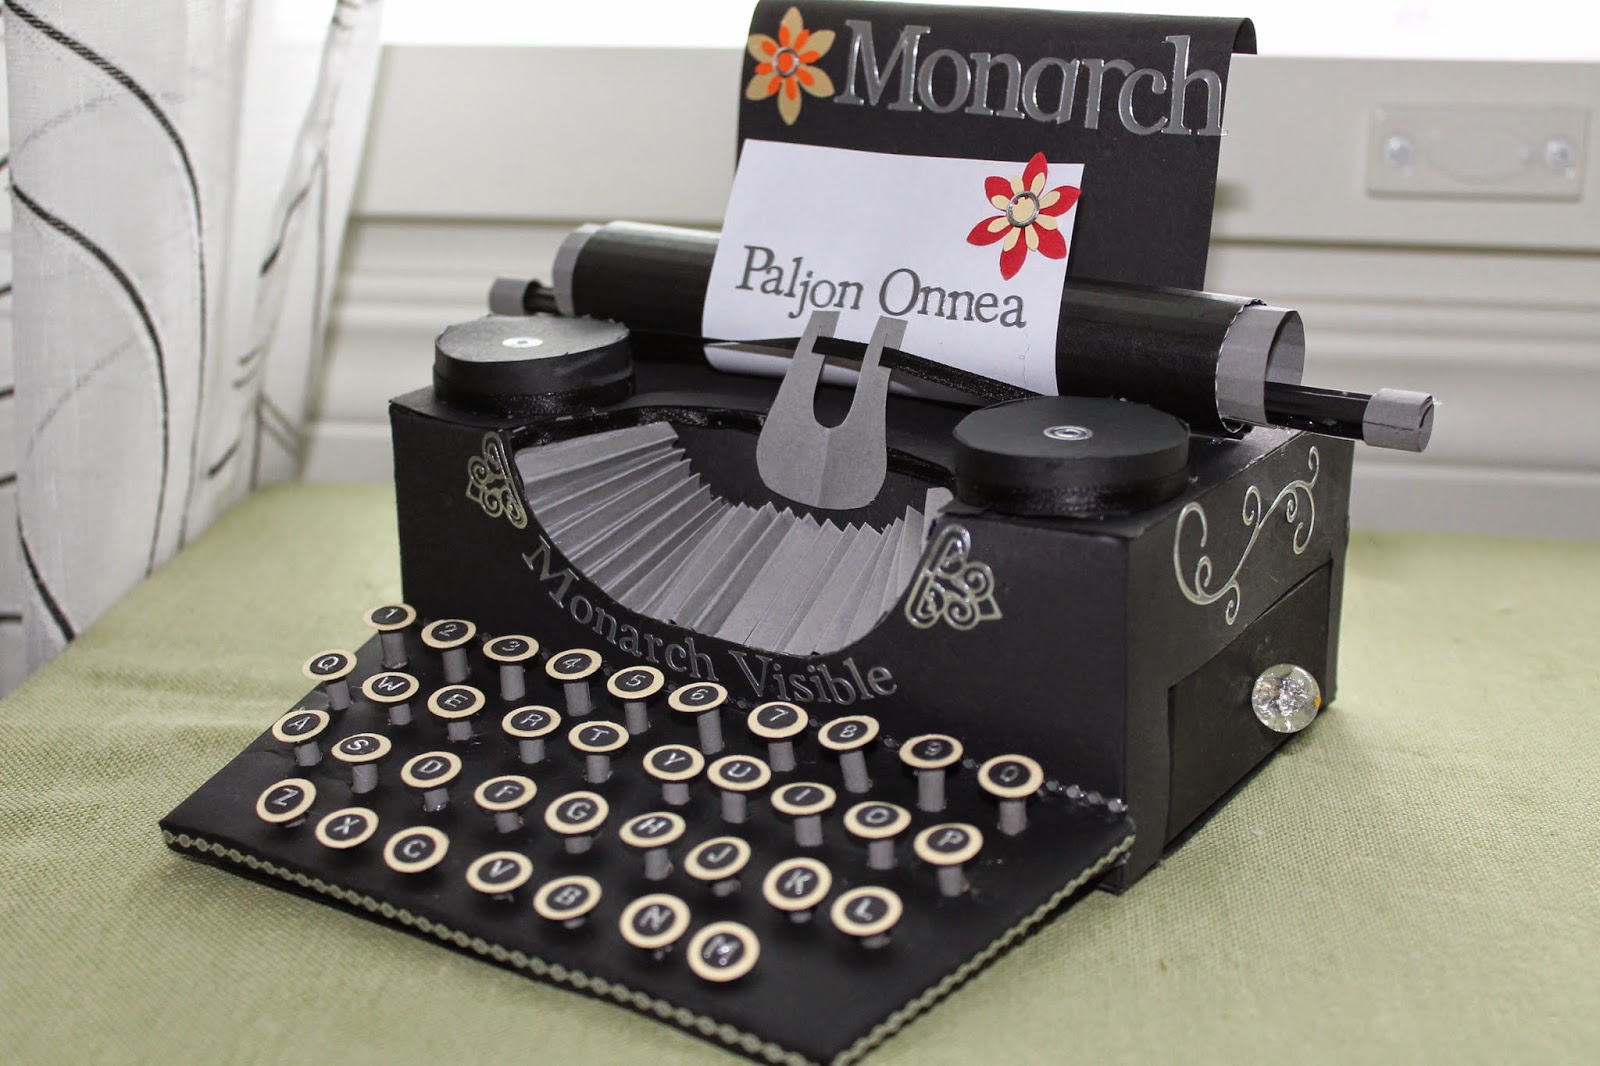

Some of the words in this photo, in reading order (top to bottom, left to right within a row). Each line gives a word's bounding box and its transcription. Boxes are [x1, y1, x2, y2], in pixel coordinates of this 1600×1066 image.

[833, 19, 1228, 136] Monarch
[735, 245, 863, 319] Paljon
[878, 268, 1028, 330] Onnea
[438, 623, 458, 637] 2
[501, 640, 521, 652] 3
[562, 656, 582, 670] 4
[625, 674, 647, 687] 5
[689, 689, 709, 702] 6
[769, 707, 789, 722] 7
[839, 724, 858, 738] 8
[923, 741, 943, 756] 9
[521, 534, 719, 682] Monarch
[728, 649, 898, 706] Visible
[287, 716, 311, 732] A
[347, 738, 370, 751] S
[418, 759, 442, 774] D
[494, 784, 520, 798] F
[566, 802, 591, 820] G
[637, 817, 667, 834] H
[707, 846, 733, 863] J
[784, 869, 813, 895] K
[854, 898, 873, 921] L
[317, 656, 340, 670] Q
[378, 676, 405, 692] W
[444, 693, 469, 708] E
[519, 713, 543, 727] R
[590, 728, 609, 742] T
[663, 752, 686, 766] Y
[727, 763, 751, 778] U
[865, 807, 889, 823] O
[937, 830, 964, 847] P
[276, 788, 299, 807] Z
[333, 816, 360, 835] X
[402, 839, 426, 858] C
[488, 859, 515, 879] V
[554, 886, 582, 906] B
[639, 905, 672, 931] N
[703, 934, 741, 966] M
